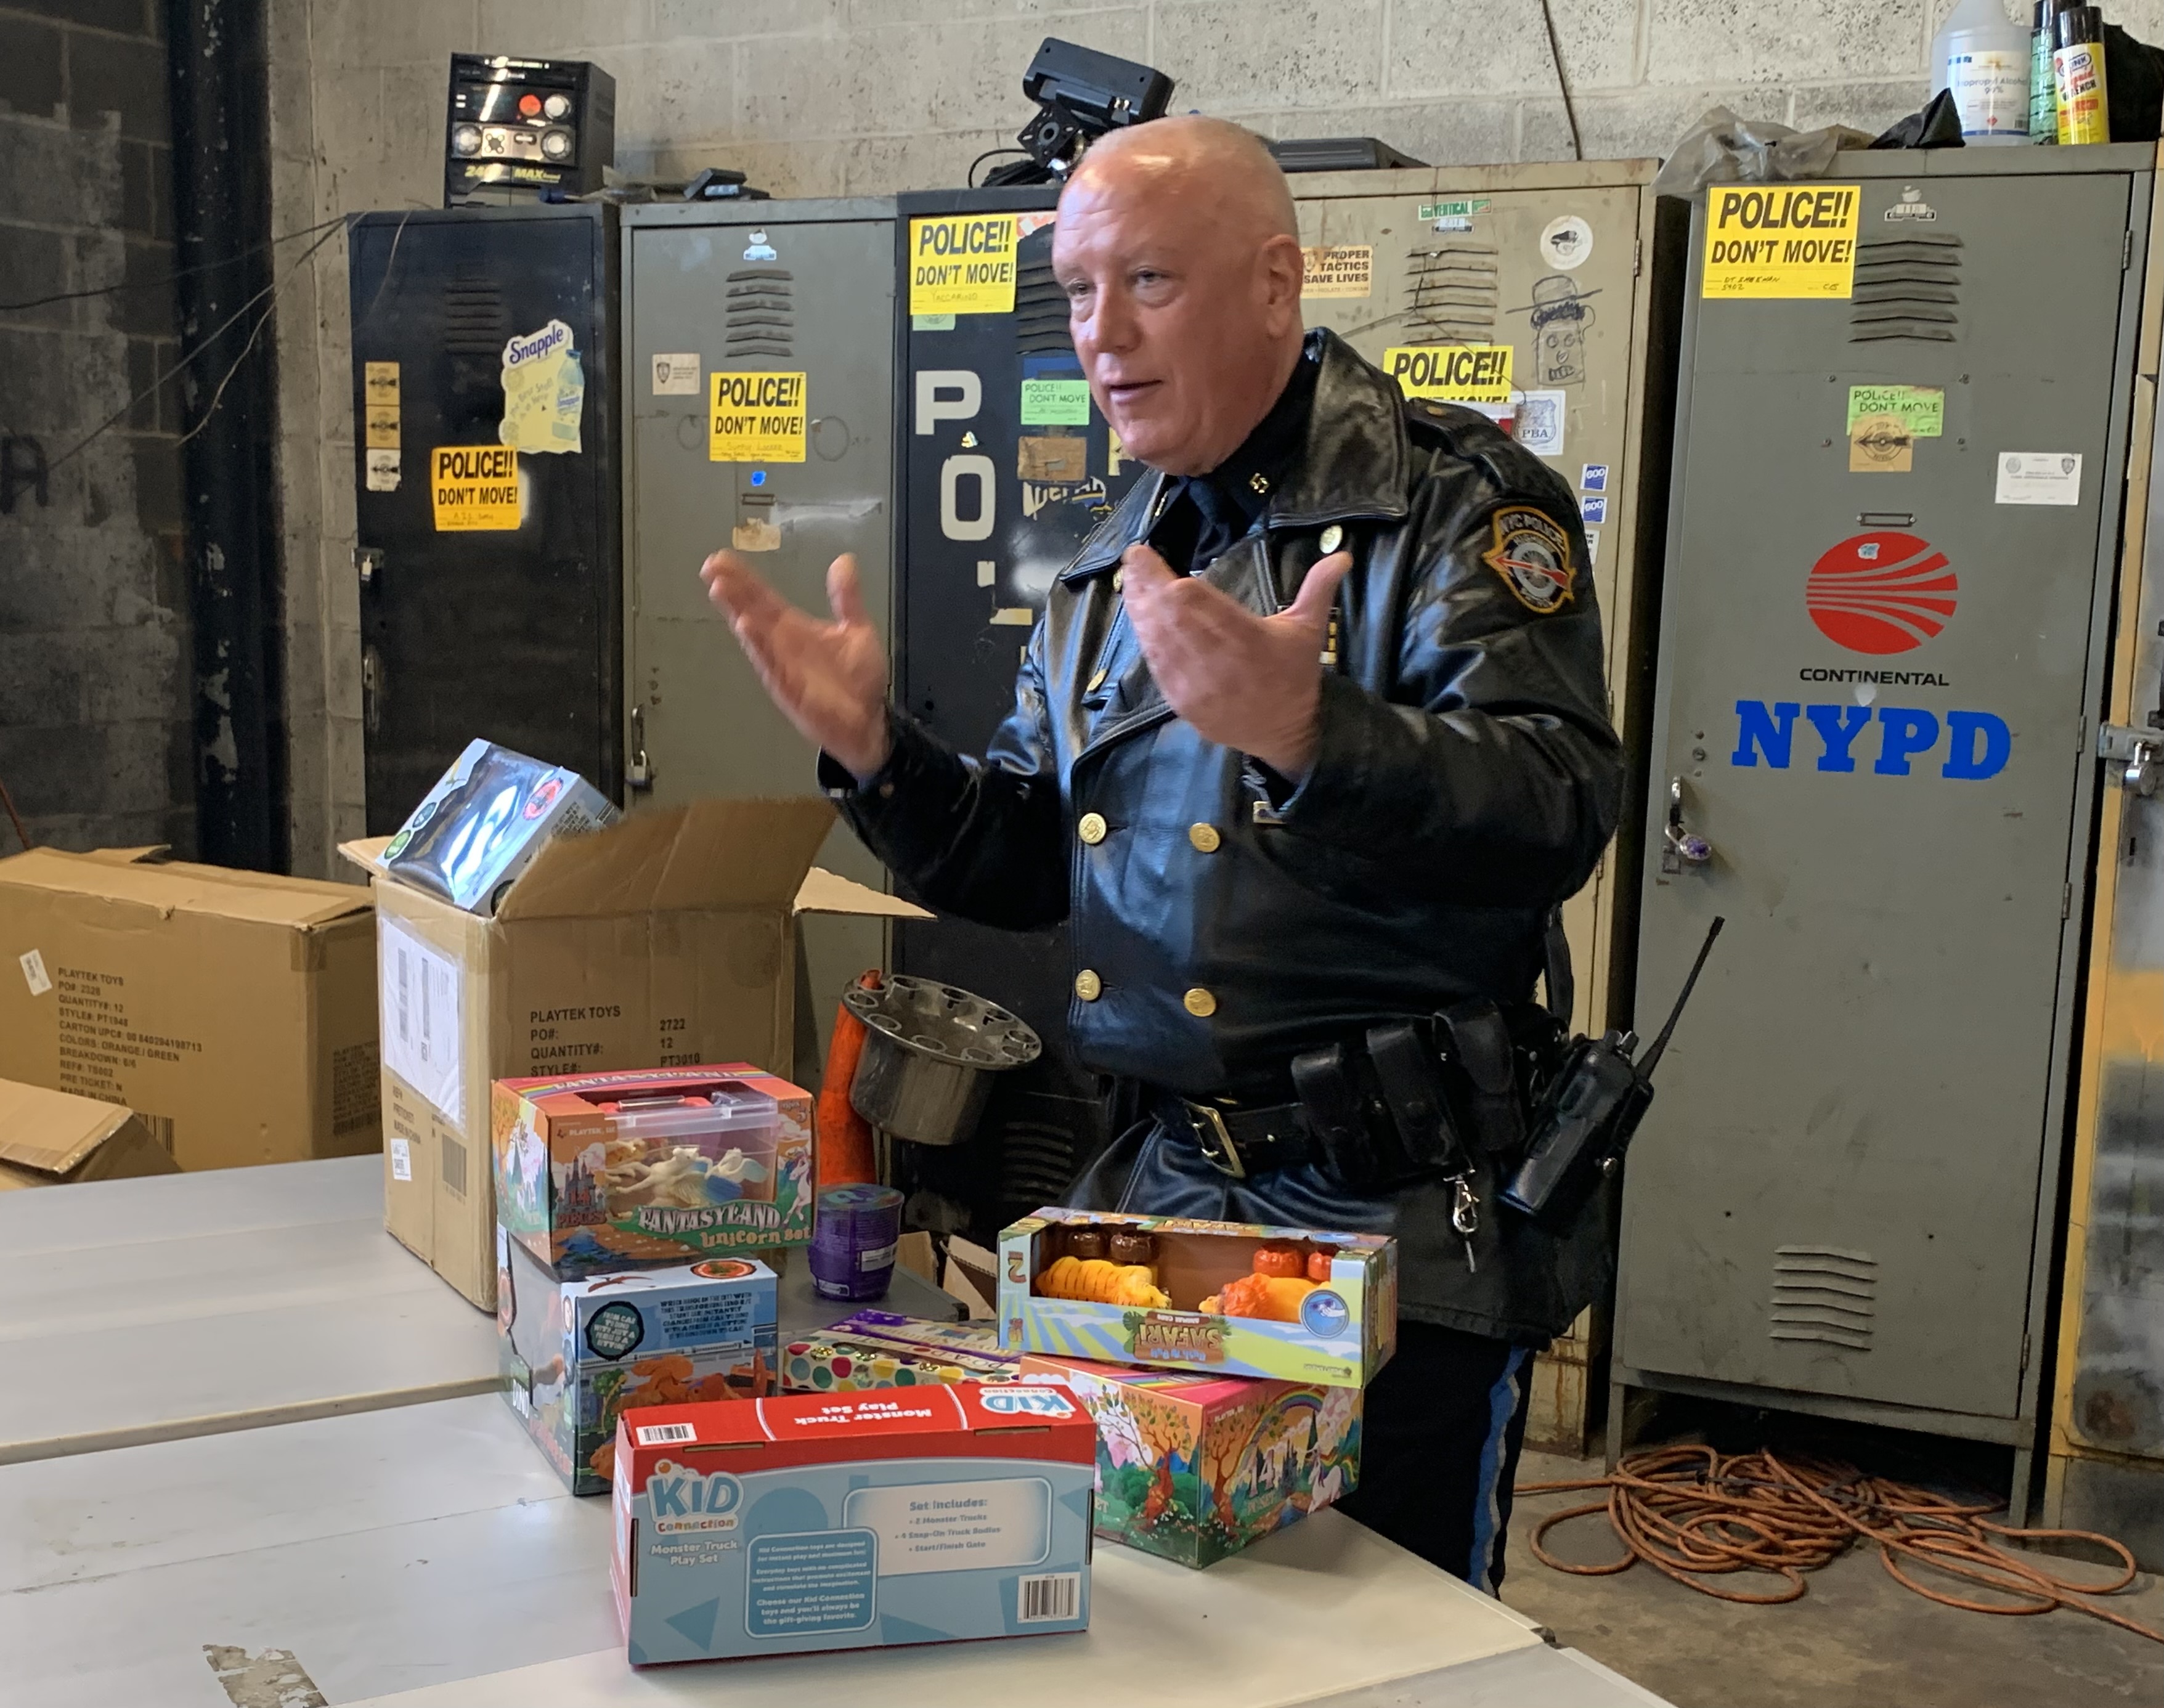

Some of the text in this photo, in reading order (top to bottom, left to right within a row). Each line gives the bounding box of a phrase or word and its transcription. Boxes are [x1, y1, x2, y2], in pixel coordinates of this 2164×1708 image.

[1958, 76, 1998, 87] Iopropyl
[514, 168, 544, 179] MAX
[1718, 190, 1853, 229] POLICE!!
[919, 220, 1012, 256] POLICE!!
[1324, 250, 1370, 260] PROPER
[1711, 238, 1852, 264] DON'T MOVE!
[916, 262, 1014, 286] DON'T MOVE!
[1320, 261, 1369, 272] TACTICS
[1304, 273, 1369, 284] SAVE LIVES
[510, 327, 564, 364] Snapple
[1394, 351, 1507, 387] POLICE!!
[718, 378, 801, 407] POLICE!!
[1059, 394, 1086, 403] MOVE
[1901, 402, 1938, 413] MOVE
[715, 416, 803, 435] DON'T MOVE!
[1522, 429, 1548, 438] PBA
[439, 450, 514, 479] POLICE!!
[438, 487, 518, 506] DON'T MOVE!
[1799, 668, 1950, 687] CONTINENTAL
[1731, 699, 2012, 781] NYPD
[58, 967, 98, 982] PLAYTEK
[100, 974, 124, 986] TOYS
[114, 1003, 123, 1014] 12
[531, 1006, 621, 1023] PLAYTEK TOYS
[59, 1020, 97, 1035] CARTON
[531, 1028, 559, 1041] PO#:
[147, 1048, 180, 1062] GREEN
[531, 1037, 673, 1060] QUANTITY#: 12
[531, 1053, 701, 1077] STYLE#: PT3010
[60, 1073, 77, 1084] PRE
[99, 1092, 128, 1107] CHINA
[570, 1188, 591, 1206] 14
[557, 1210, 607, 1228] PIECES
[638, 1205, 782, 1235] FANTASYLAND
[821, 1402, 898, 1415] Play Set
[986, 1395, 1072, 1412] KID
[794, 1409, 933, 1426] Monster Truck
[652, 1476, 740, 1518] KID
[909, 1498, 988, 1511] Set Includes:
[657, 1518, 734, 1532] Connection
[922, 1516, 957, 1524] Monster
[959, 1514, 987, 1522] Trucks
[908, 1530, 946, 1539] Snap-On
[948, 1528, 970, 1537] Truck
[651, 1540, 738, 1556] Monster Truck
[915, 1540, 986, 1552] Start/Finish Gate
[670, 1553, 718, 1566] Play Set
[803, 1595, 818, 1603] Kid
[819, 1593, 866, 1602] Connection
[778, 1614, 822, 1625] gift-giving
